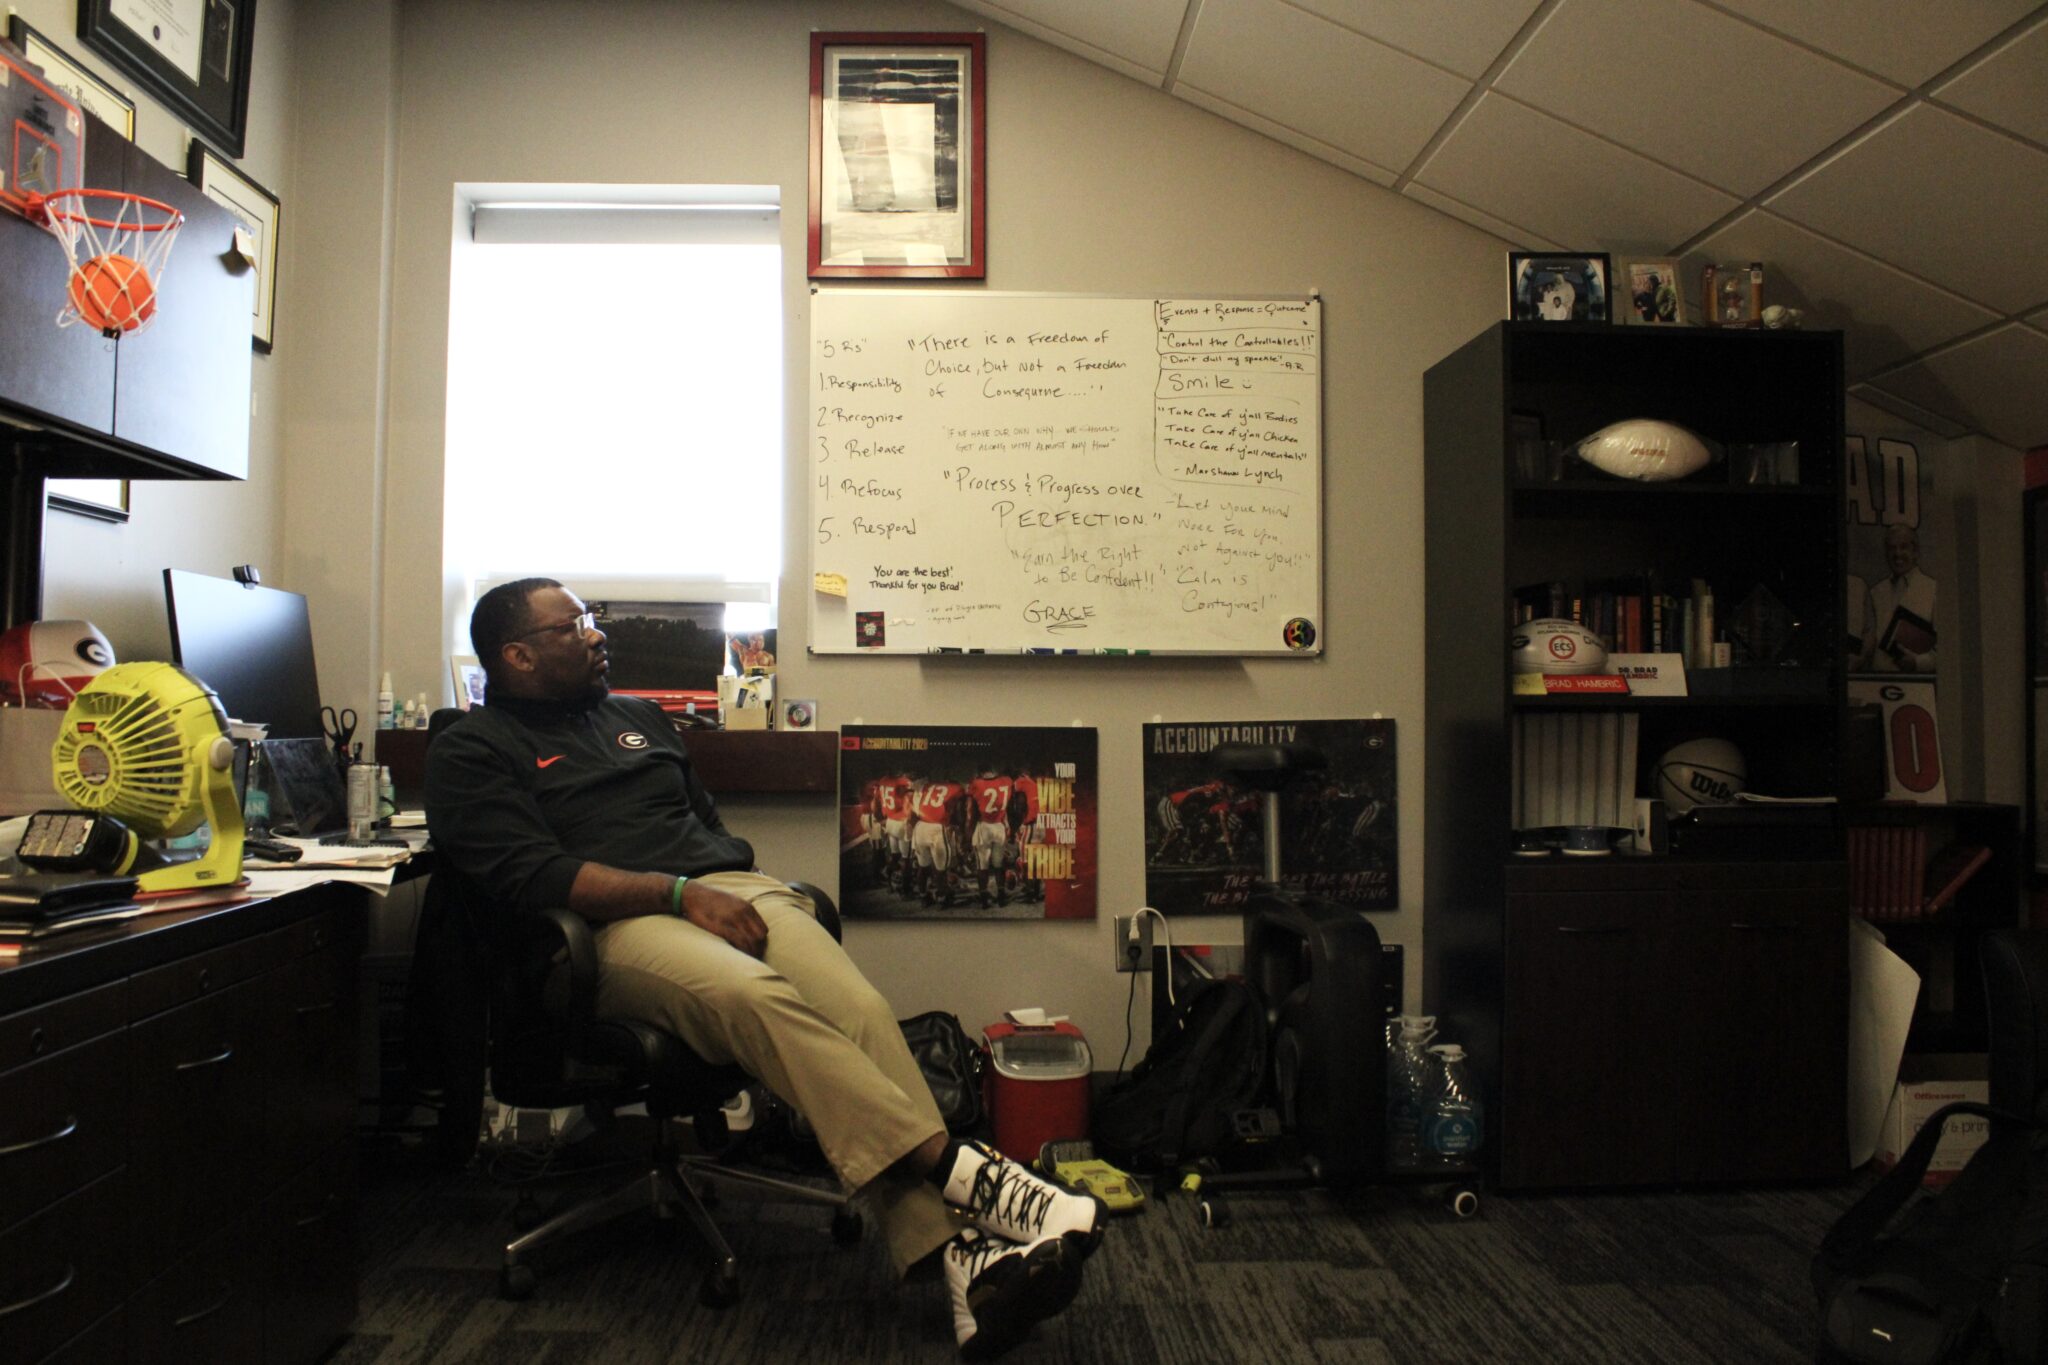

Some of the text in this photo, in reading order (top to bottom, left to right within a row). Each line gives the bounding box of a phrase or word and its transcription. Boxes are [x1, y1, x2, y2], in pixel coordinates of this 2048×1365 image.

[985, 331, 998, 345] is
[1006, 334, 1016, 344] a
[1094, 329, 1110, 344] of
[1209, 337, 1228, 347] the
[1056, 364, 1066, 373] a
[929, 382, 946, 398] of
[1221, 409, 1232, 418] of
[1165, 424, 1195, 433] Take
[1228, 427, 1237, 436] of
[844, 439, 905, 460] Release
[1164, 438, 1195, 449] Take
[1225, 444, 1235, 452] of
[841, 478, 902, 501] Refocus
[1037, 474, 1100, 503] Progress
[853, 516, 916, 540] Respond
[1062, 546, 1089, 563] the
[874, 565, 893, 578] You
[896, 569, 910, 577] are
[913, 566, 928, 577] the
[1034, 573, 1049, 585] to
[1060, 566, 1077, 583] Be
[906, 580, 919, 589] for
[921, 583, 937, 595] you
[1554, 642, 1572, 651] ECS
[1634, 666, 1658, 675] BRAD
[1545, 679, 1622, 689] BRAD HAMBRIC
[1055, 763, 1076, 778] YOUR
[923, 785, 948, 808] 13
[984, 786, 1009, 813] 27
[1036, 778, 1076, 813] VIBE
[1036, 813, 1076, 829] ATTRACTS
[1055, 829, 1076, 845] YOUR
[1024, 844, 1076, 880] TRIBE
